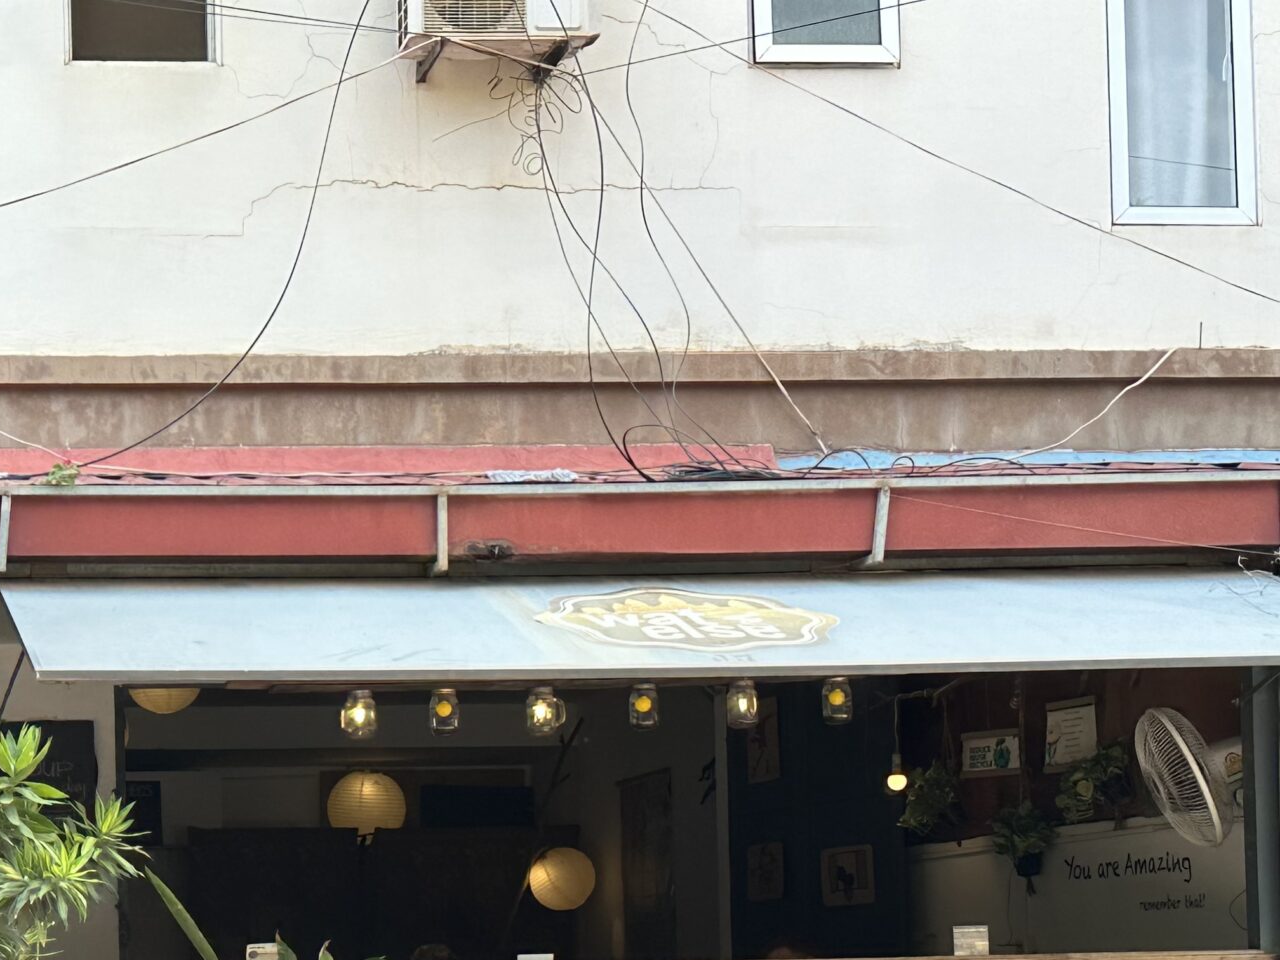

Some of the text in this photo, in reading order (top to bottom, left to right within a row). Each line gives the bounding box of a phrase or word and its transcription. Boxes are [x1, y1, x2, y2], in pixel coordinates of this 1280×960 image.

[584, 607, 719, 627] wat
[641, 612, 786, 639] else
[1064, 852, 1192, 883] You are Amazing
